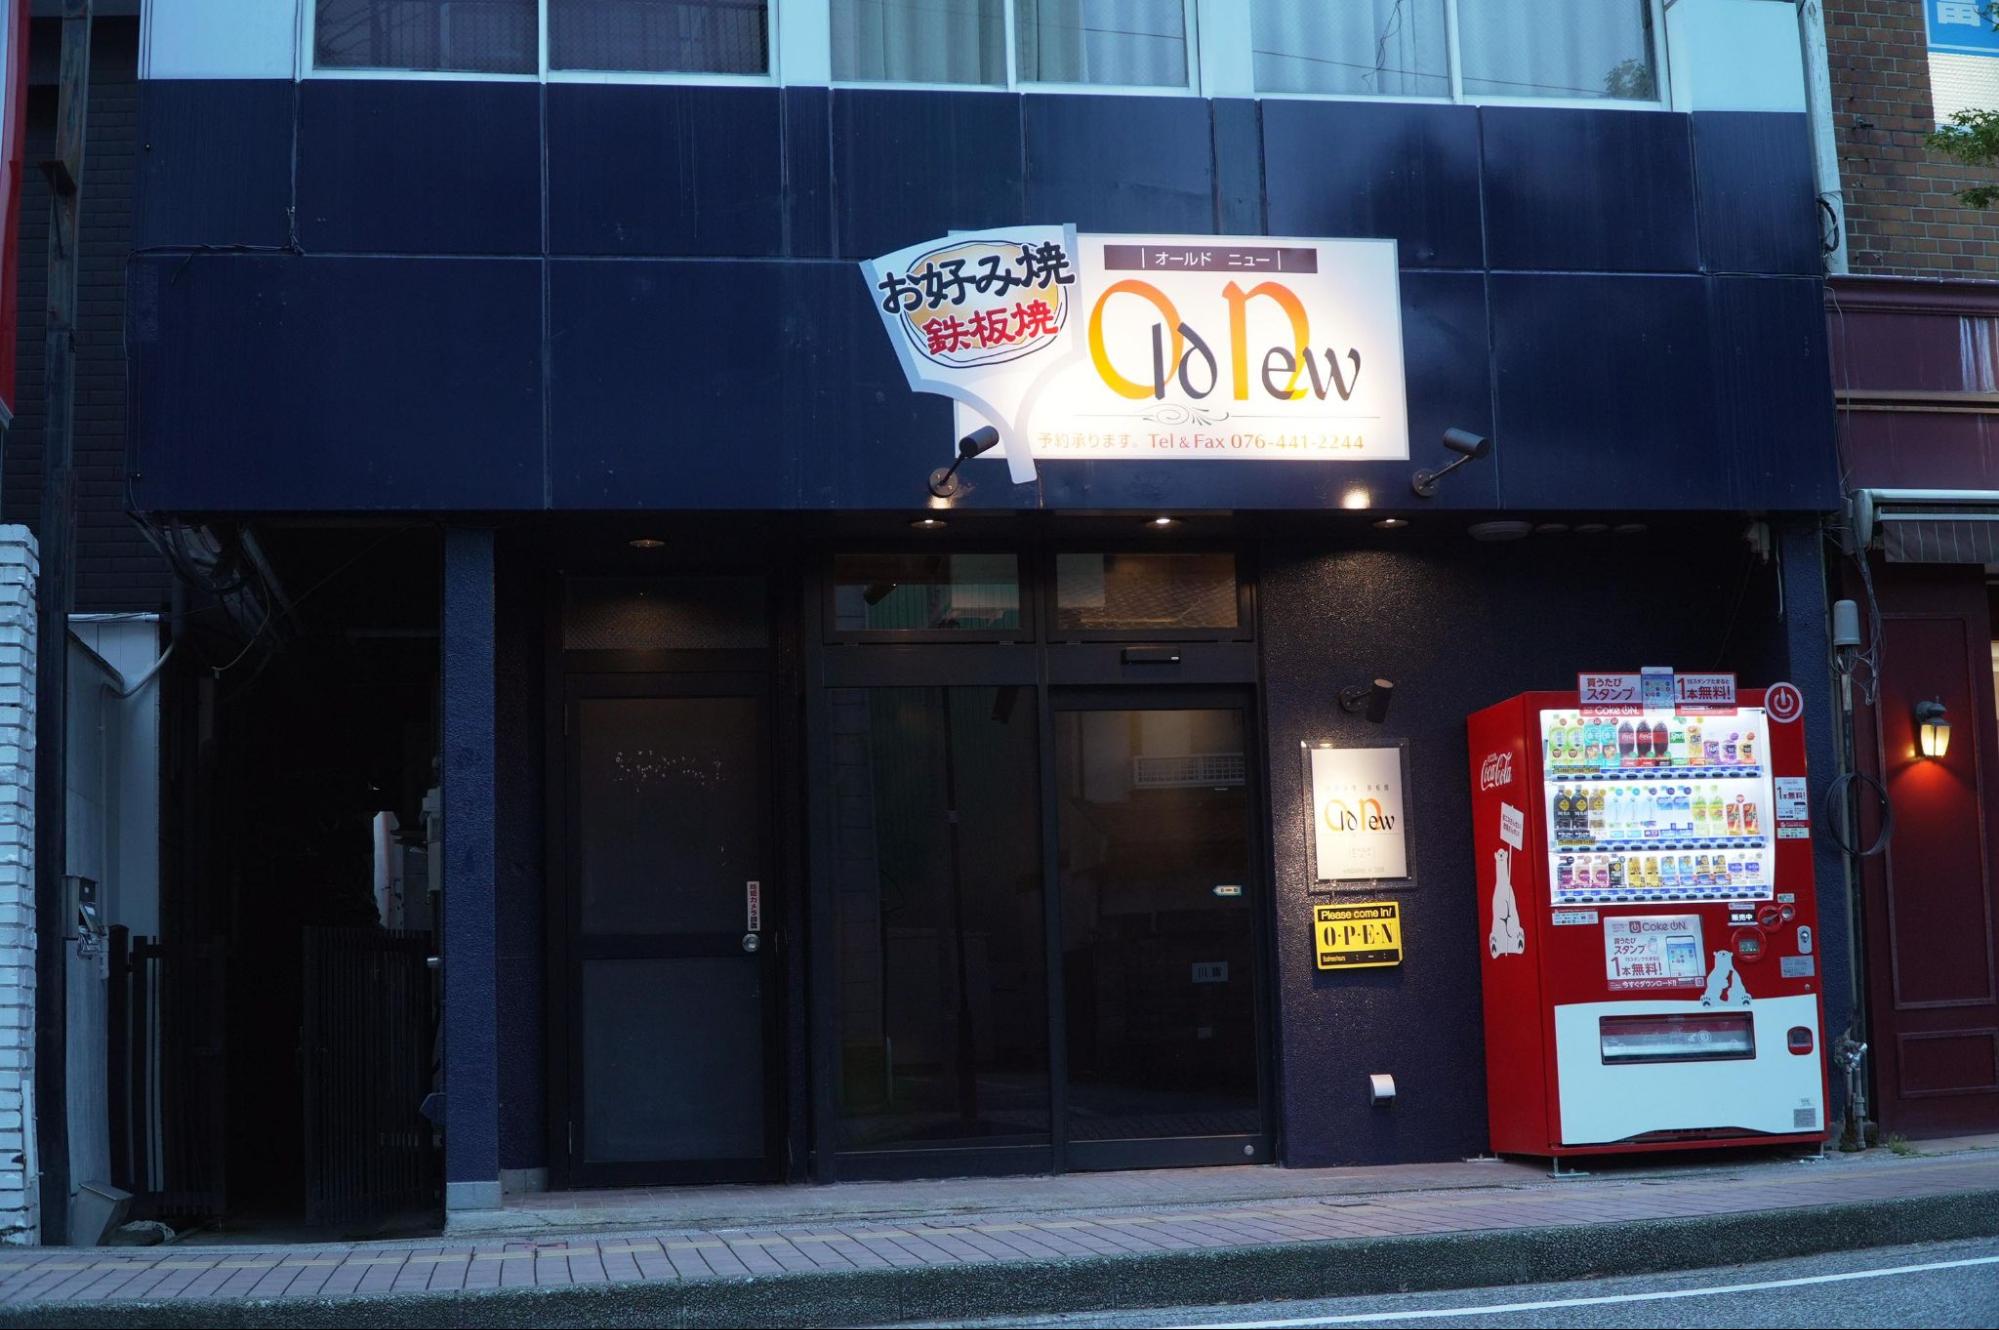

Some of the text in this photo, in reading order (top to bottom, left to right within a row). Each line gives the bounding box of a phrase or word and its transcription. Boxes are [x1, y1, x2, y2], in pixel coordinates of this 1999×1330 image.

[1155, 251, 1270, 267] オールド ニュー
[879, 241, 1075, 314] お好み焼
[922, 299, 1059, 355] 鉄板焼
[1089, 279, 1217, 400] Old
[1038, 432, 1364, 450] 予約承ります。 Tel & Fax 076-441-2244
[1587, 677, 1622, 688] 買うたび
[1677, 677, 1731, 700] 1本無料!
[1586, 687, 1635, 701] スタンプ
[1595, 706, 1622, 716] Coke
[1321, 910, 1352, 920] Please
[1353, 909, 1379, 918] come
[1642, 920, 1687, 932] Coke ON
[1614, 937, 1636, 945] 買うたび
[1613, 944, 1647, 955] スタンプ
[1611, 956, 1663, 977] 1本無料!
